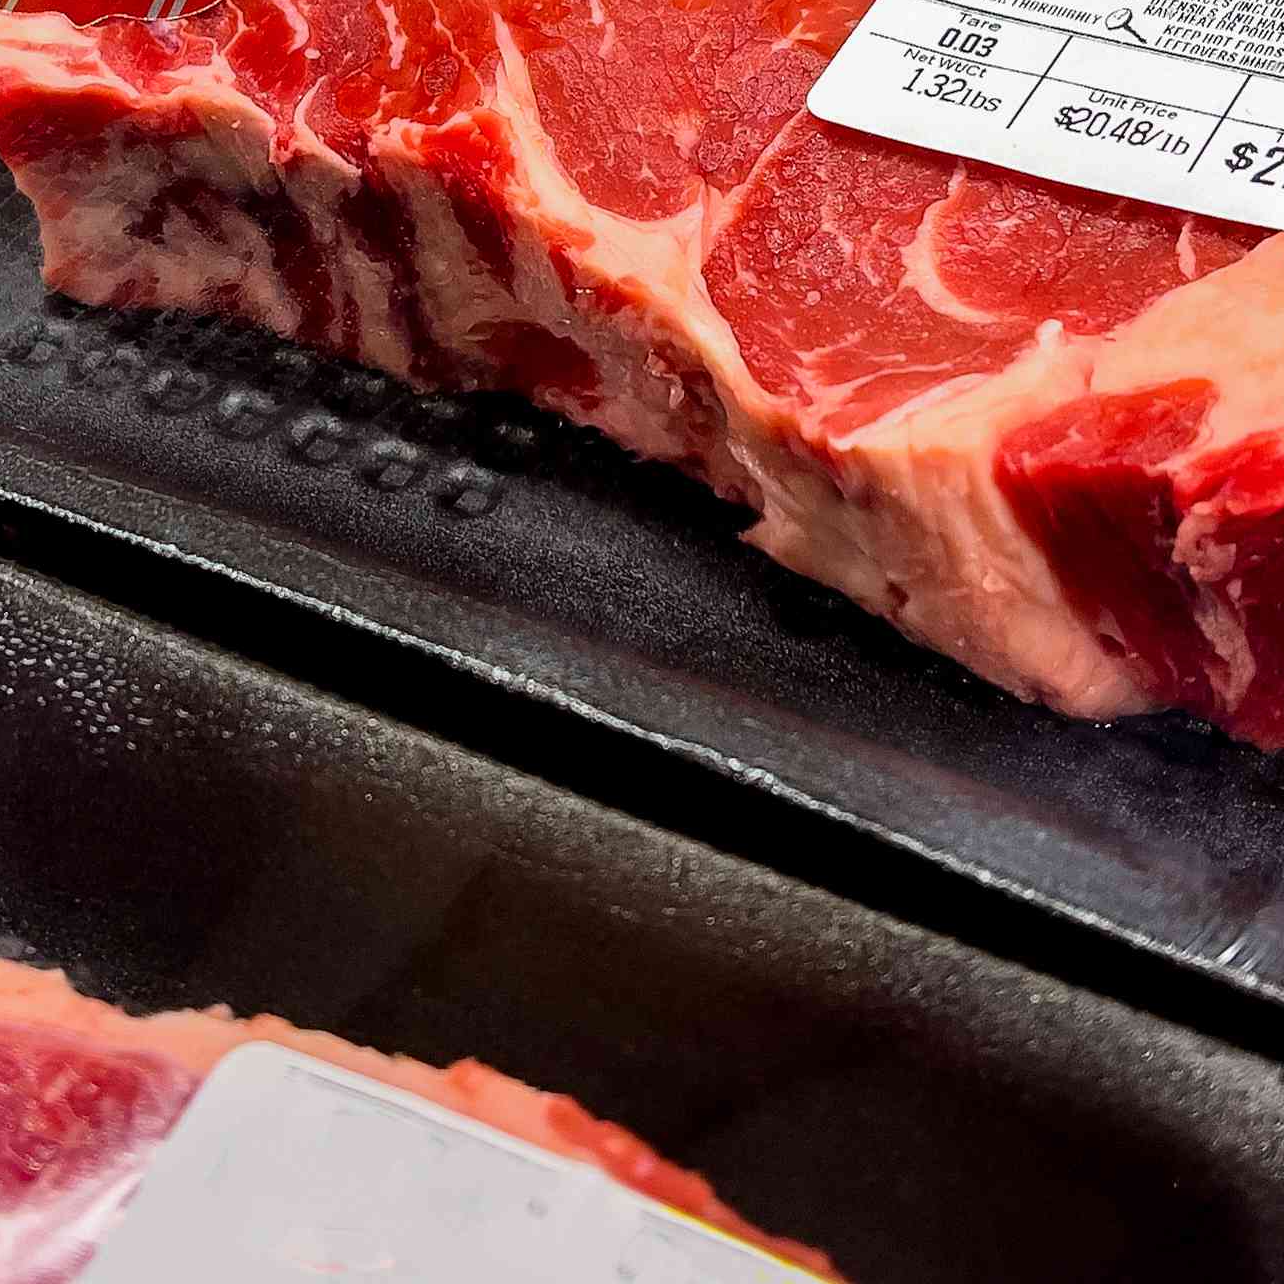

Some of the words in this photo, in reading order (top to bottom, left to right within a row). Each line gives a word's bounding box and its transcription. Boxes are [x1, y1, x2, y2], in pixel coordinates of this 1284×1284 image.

[959, 11, 1001, 32] Tare
[937, 27, 998, 57] 0.03
[903, 47, 942, 65] Net
[1088, 91, 1127, 109] Unit
[1130, 100, 1177, 119] Price
